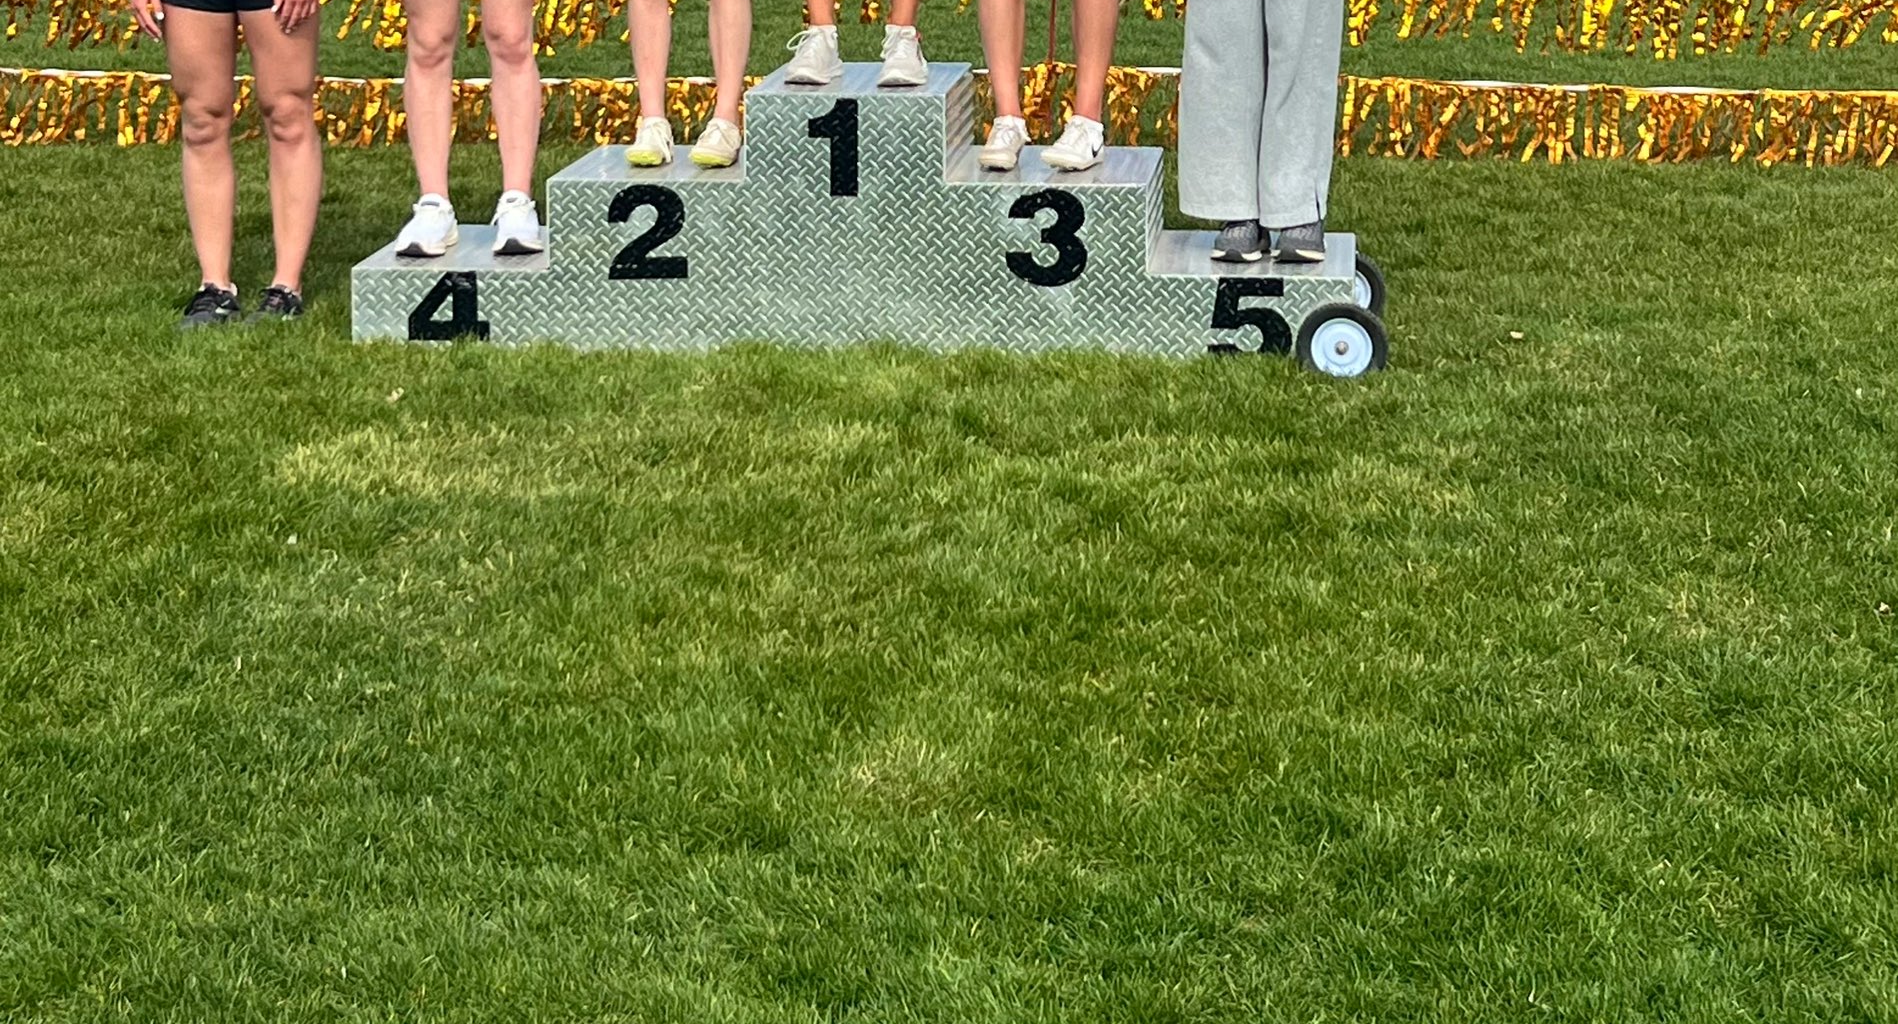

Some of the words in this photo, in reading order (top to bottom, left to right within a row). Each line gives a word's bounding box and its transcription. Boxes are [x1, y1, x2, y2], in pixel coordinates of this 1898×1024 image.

[808, 98, 858, 197] 1
[607, 183, 689, 280] 2
[1005, 188, 1088, 287] 3
[408, 271, 491, 342] 4
[1207, 277, 1293, 355] 5
